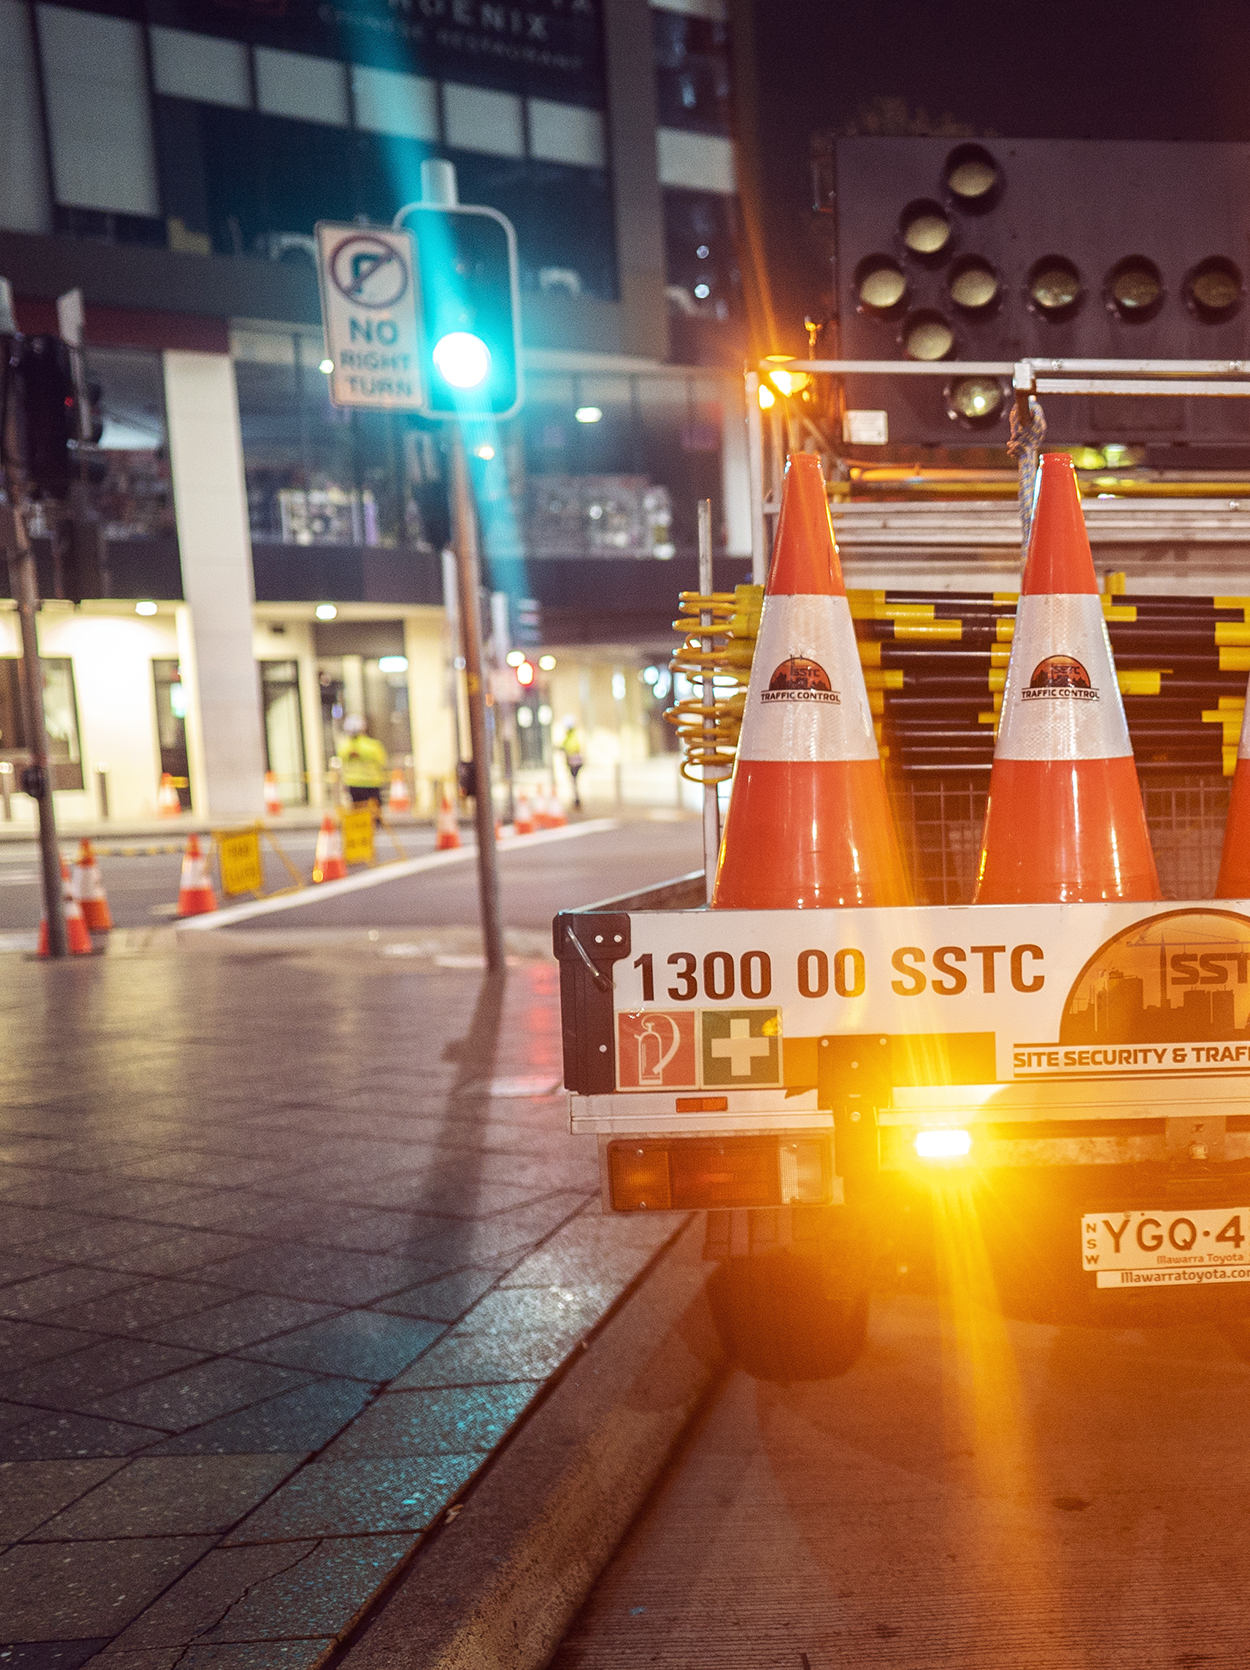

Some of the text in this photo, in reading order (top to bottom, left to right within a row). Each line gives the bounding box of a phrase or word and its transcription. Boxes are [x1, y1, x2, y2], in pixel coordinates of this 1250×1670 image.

[348, 317, 400, 346] NO
[340, 350, 411, 371] RIGHT
[347, 375, 413, 396] TURN
[761, 691, 841, 702] TRAFFIC CONTROL
[1021, 689, 1100, 699] TRAFFIC CONTROL
[633, 943, 1045, 1001] 1300 00 SSTC
[1013, 1051, 1059, 1069] SITE
[1063, 1048, 1168, 1067] SECURITY
[1172, 1047, 1188, 1064] &
[1207, 1253, 1244, 1264] Toyota
